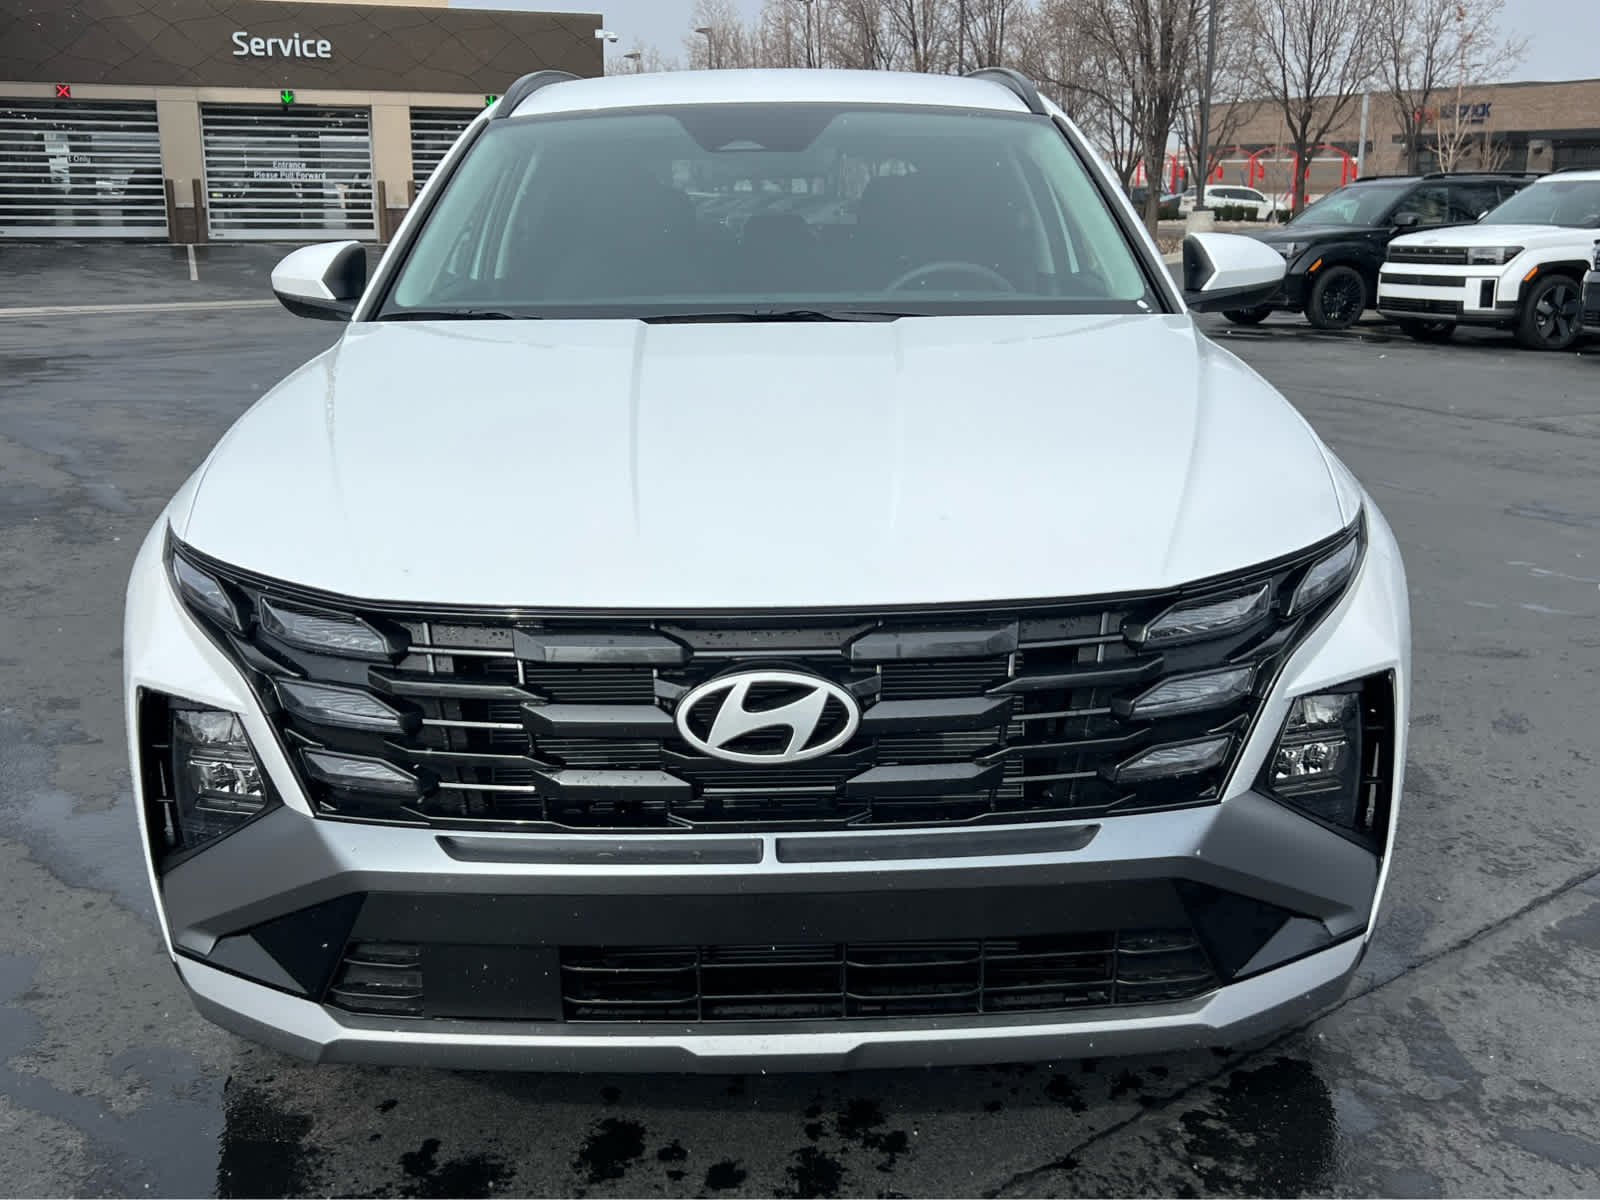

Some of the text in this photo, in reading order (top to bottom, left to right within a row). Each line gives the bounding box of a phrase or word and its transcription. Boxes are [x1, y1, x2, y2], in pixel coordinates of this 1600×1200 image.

[231, 31, 332, 58] Service
[272, 160, 306, 169] Entrance
[253, 170, 326, 180] Please Pull Forward
